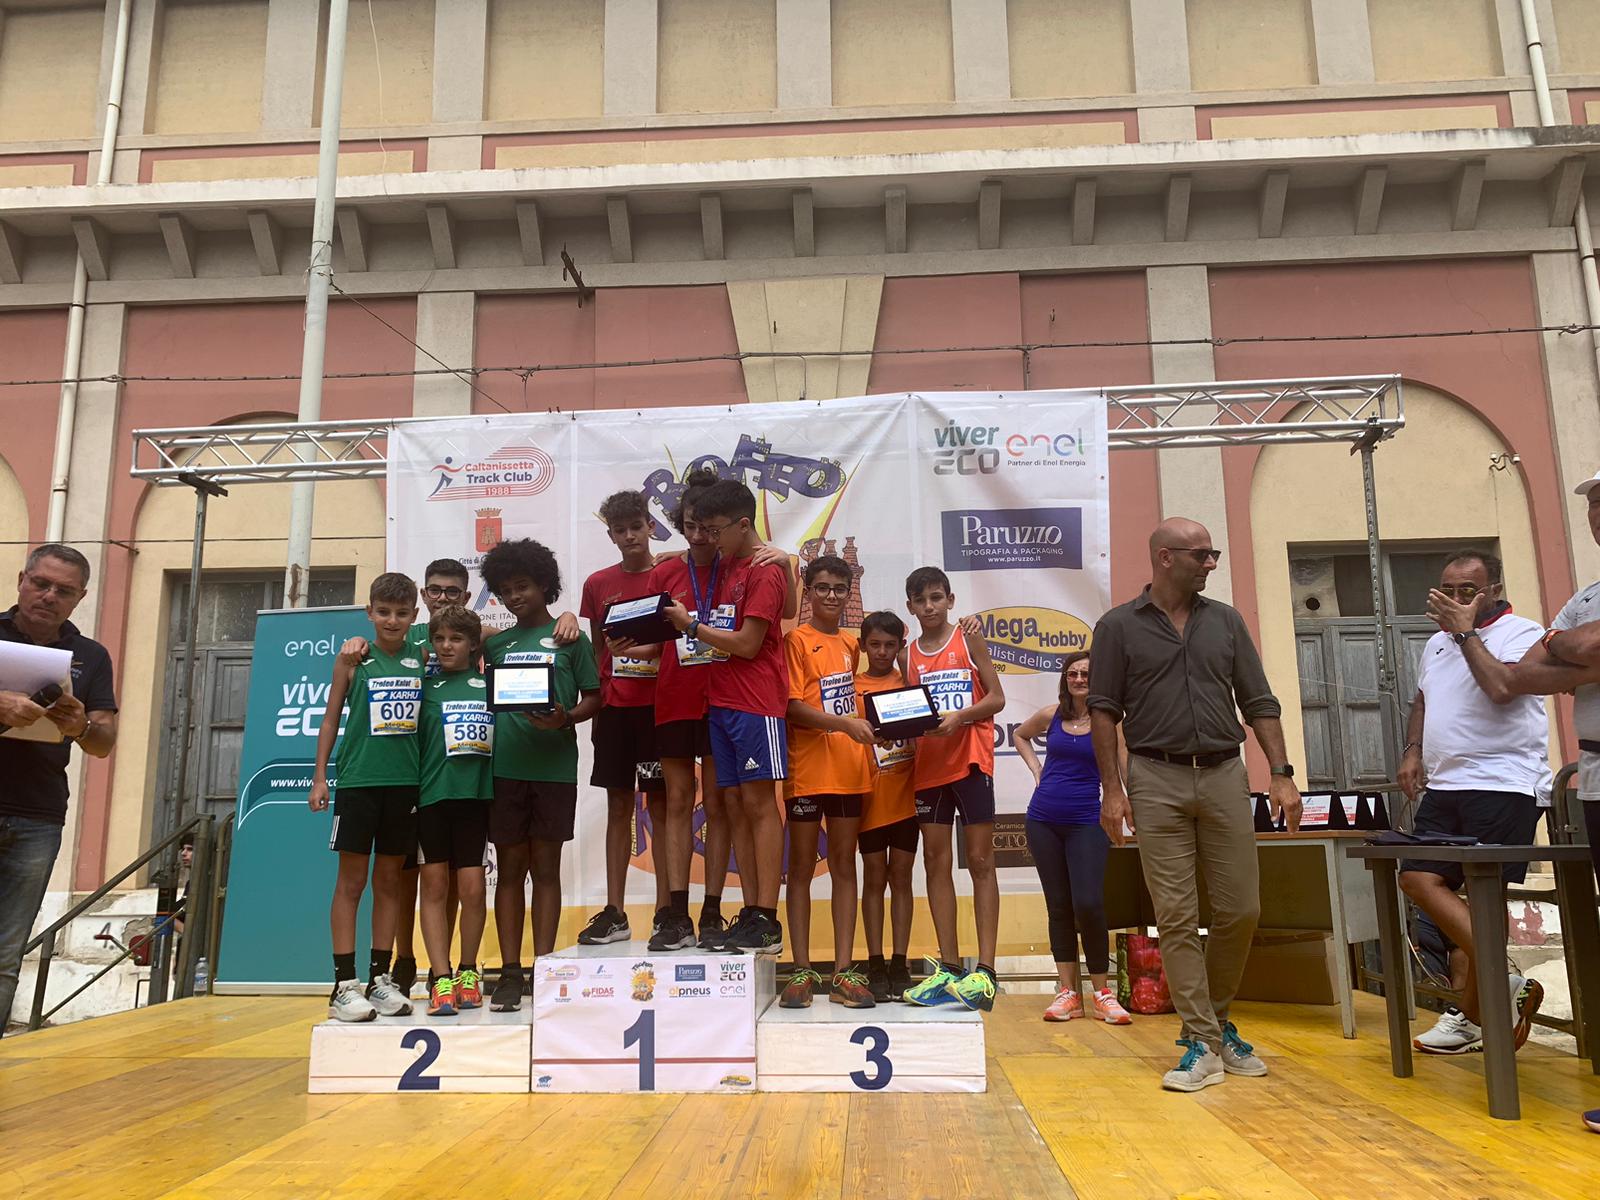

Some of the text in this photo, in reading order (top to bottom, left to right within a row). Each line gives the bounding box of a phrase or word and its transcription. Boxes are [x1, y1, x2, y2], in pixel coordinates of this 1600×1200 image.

[933, 419, 1000, 448] viver
[1005, 428, 1084, 457] enel
[465, 461, 534, 472] Caltanissetta
[933, 448, 1001, 476] ECO
[1007, 459, 1032, 467] Partner
[1060, 459, 1086, 467] Energia
[466, 471, 533, 484] Track Club
[487, 486, 510, 496] 1988
[959, 515, 1063, 546] Paruzzo
[961, 548, 1010, 557] TIPOGRAFIA
[1020, 547, 1064, 555] PACKAGING
[976, 614, 1039, 645] Mega
[284, 634, 336, 657] enel
[1039, 630, 1087, 650] Hobby
[987, 646, 1015, 662] alisti
[1019, 653, 1052, 669] dello
[372, 680, 394, 688] Trofeo
[937, 682, 968, 692] KARHU
[389, 691, 420, 700] KARHU
[380, 702, 415, 720] 602
[833, 696, 855, 716] 608
[462, 713, 492, 723] KARHU
[454, 724, 488, 741] 588
[720, 961, 746, 972] viver
[720, 971, 746, 982] ECO
[591, 987, 614, 995] FIDAS
[720, 984, 746, 994] enel
[624, 1009, 655, 1090] 1
[849, 1026, 893, 1090] 3
[397, 1029, 441, 1090] 2
